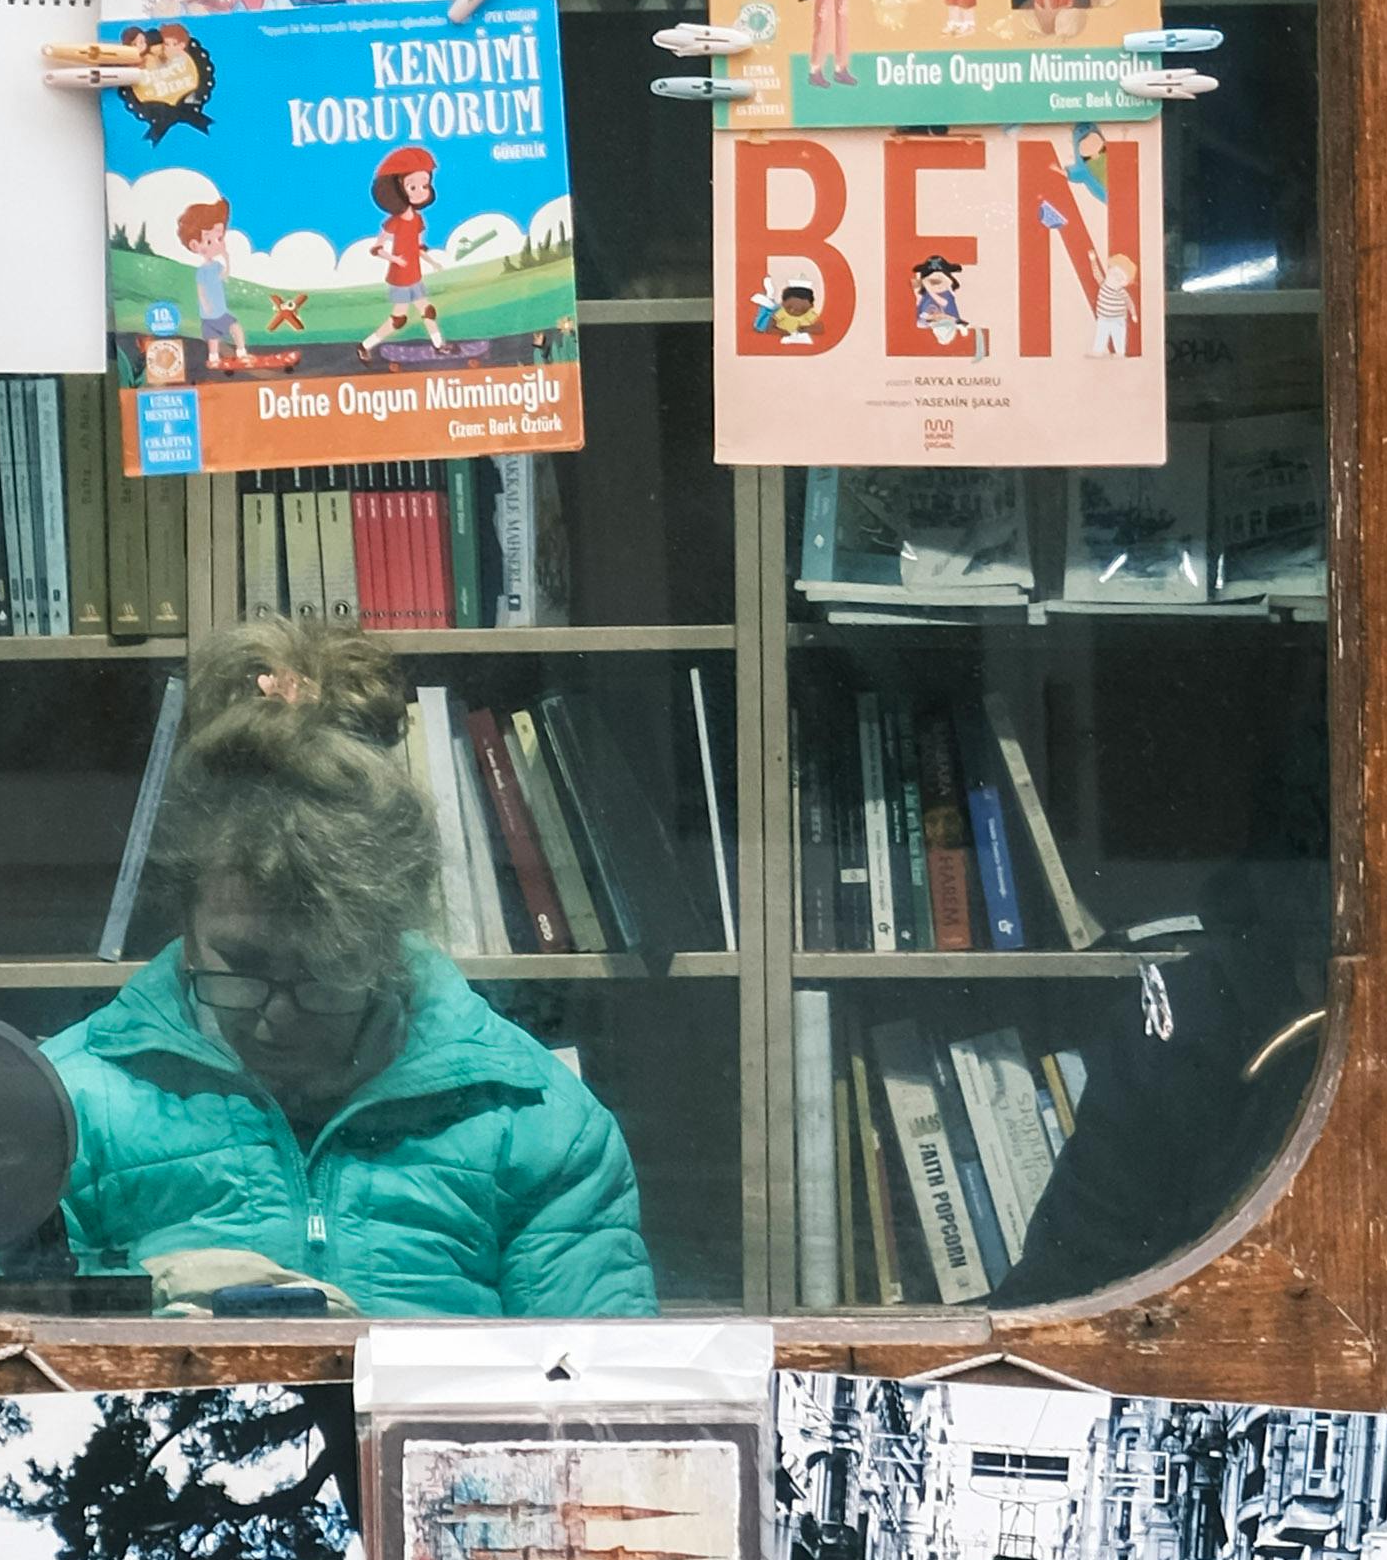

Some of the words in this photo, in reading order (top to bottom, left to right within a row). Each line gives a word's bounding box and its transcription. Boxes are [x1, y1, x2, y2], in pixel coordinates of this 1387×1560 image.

[370, 25, 541, 90] KENDİMİ
[876, 55, 942, 86] Defne
[950, 53, 1024, 92] Ongun
[288, 86, 543, 147] KORUYORUM
[735, 140, 1142, 358] BEN
[259, 385, 331, 421] Defne
[338, 381, 418, 421] Ongun
[426, 371, 561, 413] Müminoğlu
[489, 417, 518, 437] Berk
[938, 855, 960, 927] HAREM
[931, 1191, 967, 1269] POPCORN
